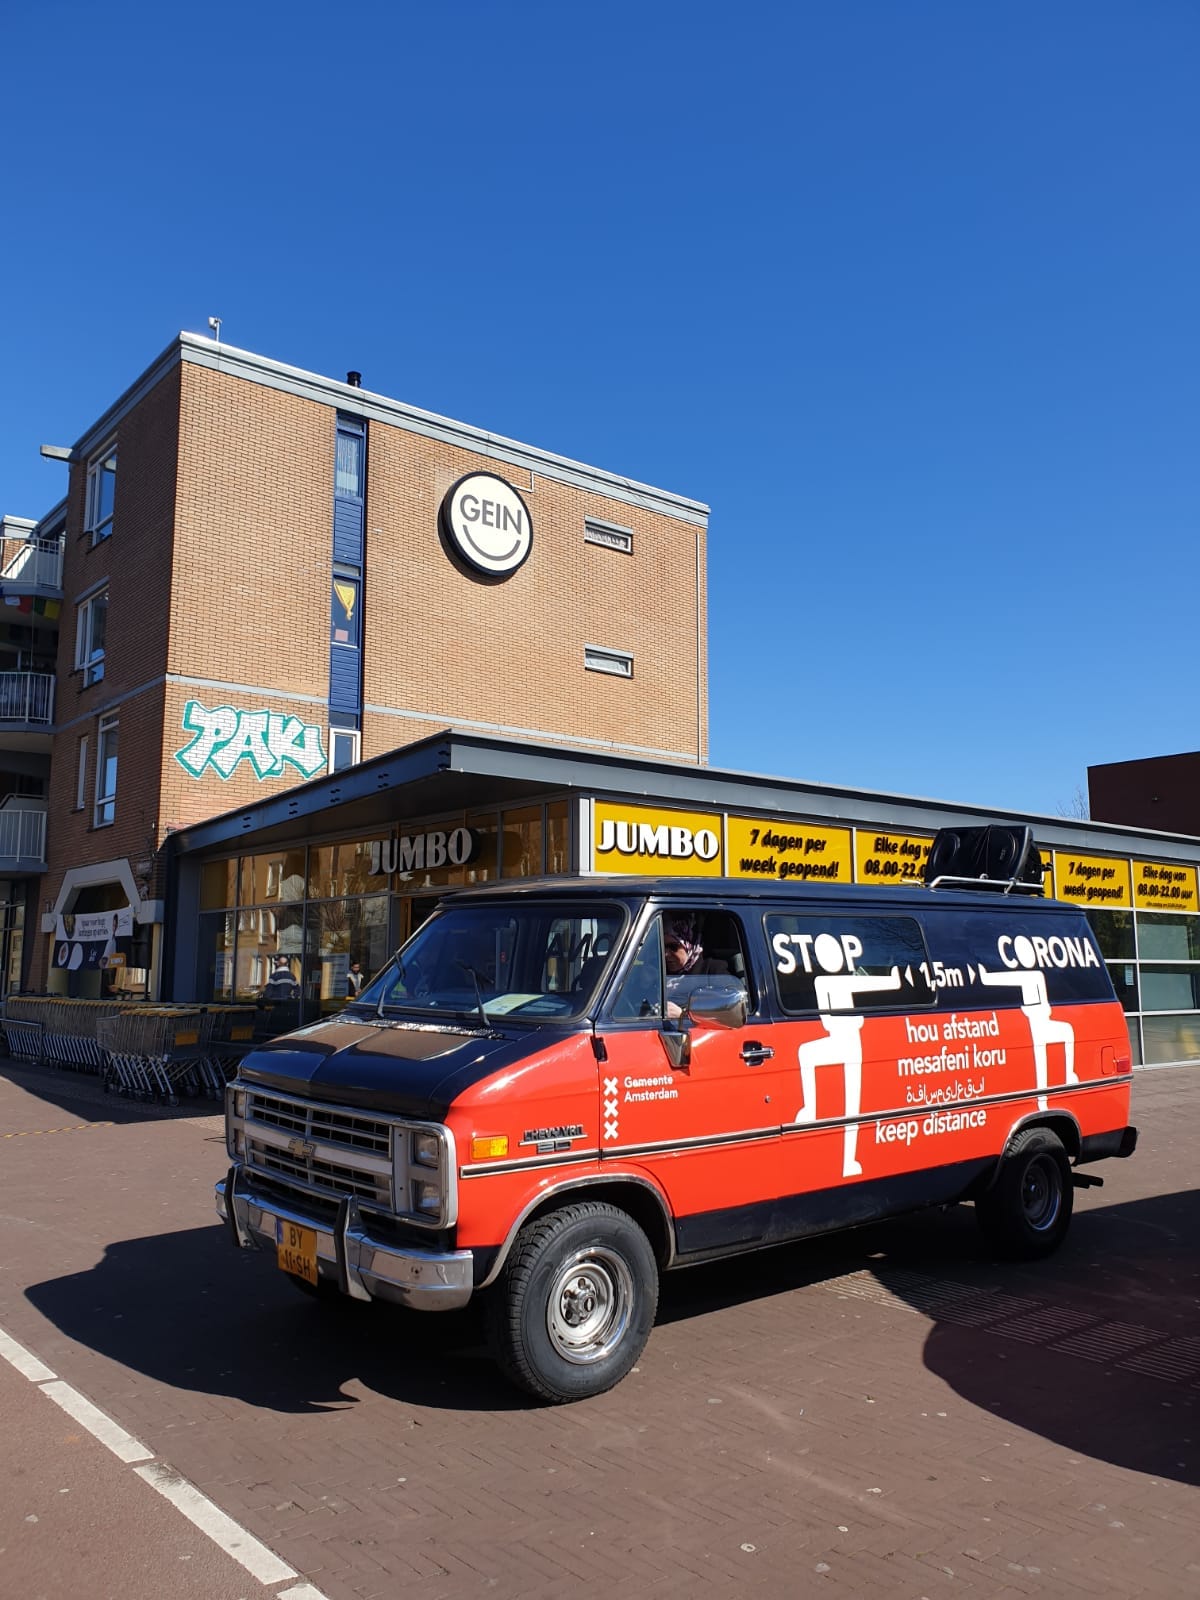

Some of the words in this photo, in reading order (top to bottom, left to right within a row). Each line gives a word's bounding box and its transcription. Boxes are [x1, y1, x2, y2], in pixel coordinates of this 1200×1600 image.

[460, 494, 522, 535] GEIN
[368, 827, 474, 876] JUMBO
[597, 819, 720, 860] JUMBO
[750, 828, 760, 846] 7
[761, 829, 803, 854] dagen
[804, 838, 827, 856] per
[874, 836, 898, 854] Elke
[900, 839, 921, 861] dag
[740, 856, 777, 874] week
[778, 860, 840, 880] geopend!
[1068, 862, 1075, 875] 7
[1076, 862, 1101, 880] dagen
[1101, 868, 1115, 881] per
[1143, 866, 1158, 878] Elke
[1159, 869, 1173, 884] dag
[1173, 871, 1187, 882] van
[1063, 883, 1086, 897] week
[1087, 886, 1124, 901] geopend!
[1138, 884, 1180, 898] 08.00-22.00
[1181, 889, 1193, 900] uur
[772, 932, 863, 974] STOP
[997, 935, 1100, 969] CORONA
[919, 961, 965, 992] 1,5m
[905, 1015, 939, 1043] hou
[943, 1011, 1000, 1041] afstand
[897, 1045, 970, 1077] mesafeni
[973, 1043, 1007, 1068] koru
[624, 1074, 673, 1088] Gemeente
[624, 1088, 679, 1103] Amsterdam
[875, 1119, 919, 1147] keep
[923, 1109, 987, 1136] distance
[289, 1227, 303, 1249] BY
